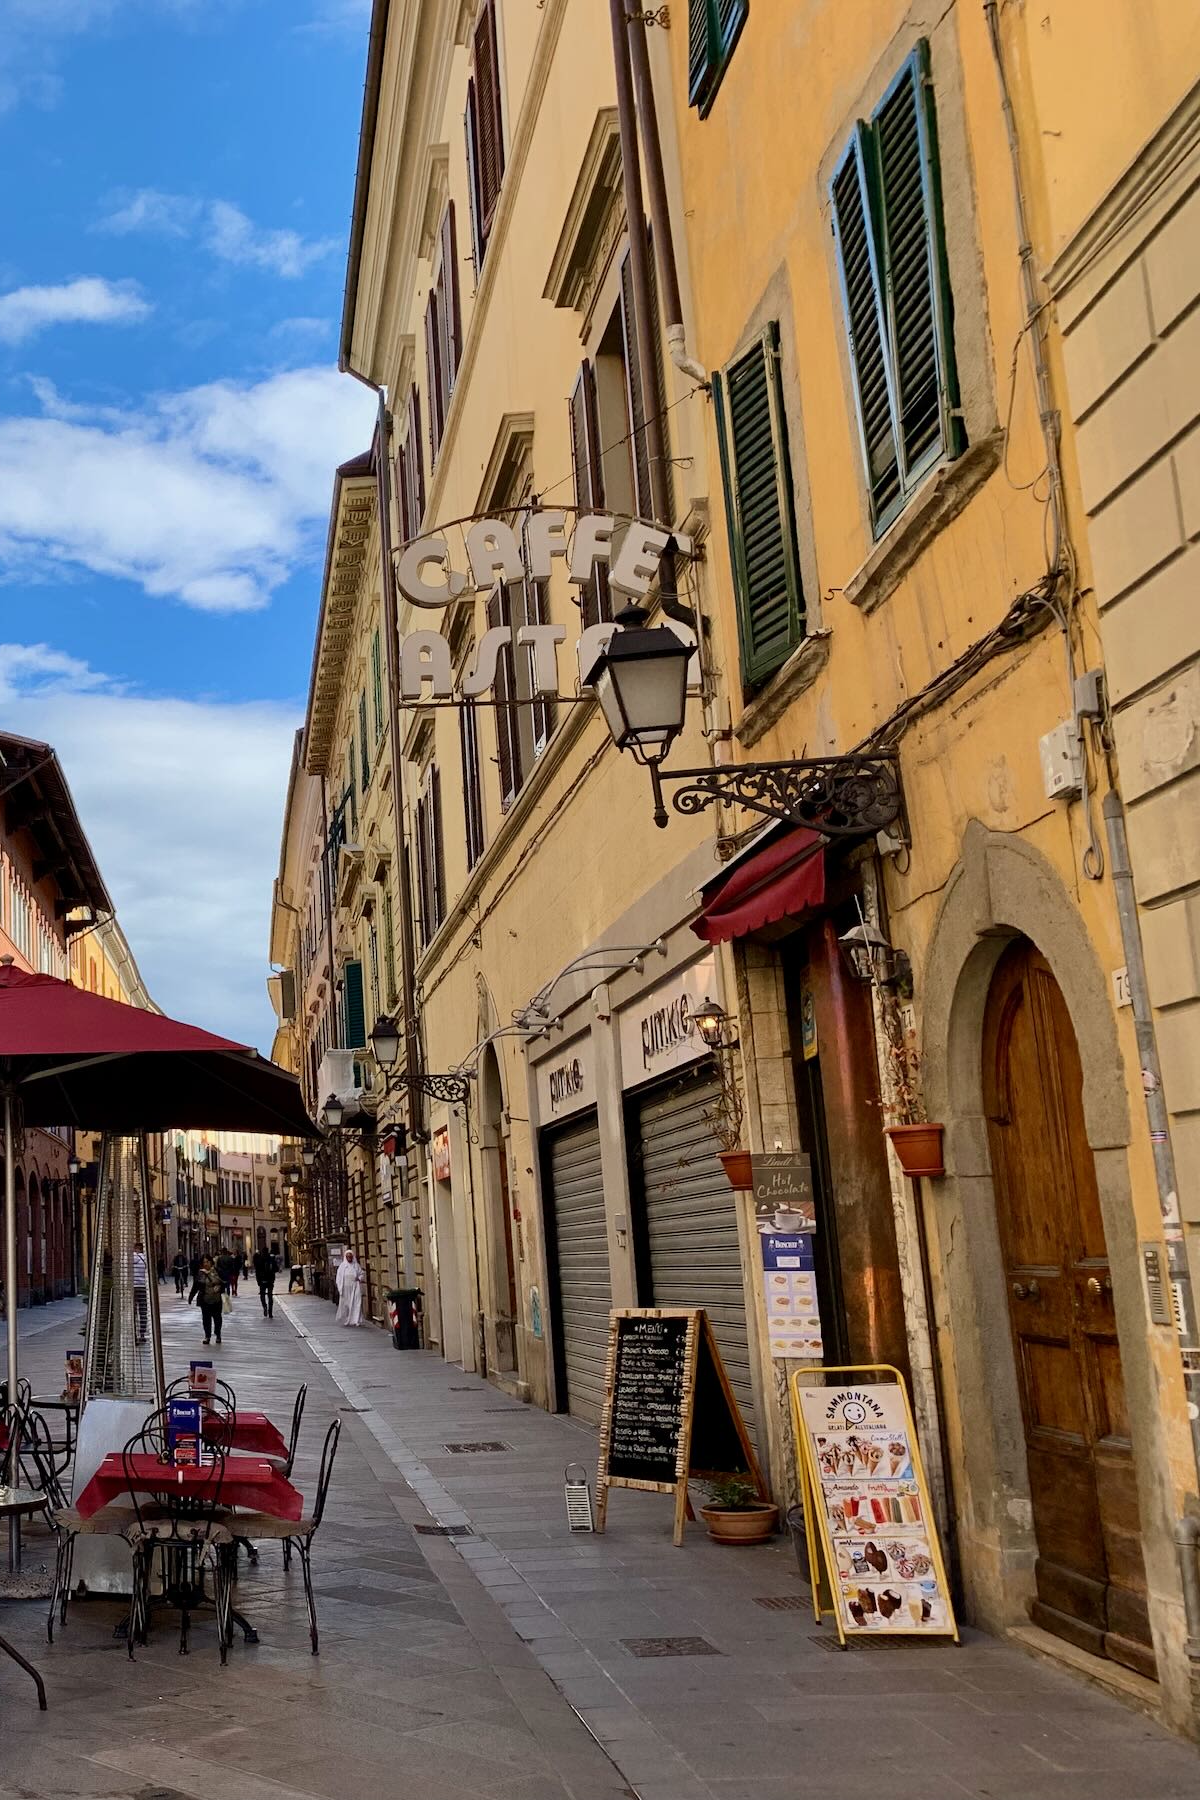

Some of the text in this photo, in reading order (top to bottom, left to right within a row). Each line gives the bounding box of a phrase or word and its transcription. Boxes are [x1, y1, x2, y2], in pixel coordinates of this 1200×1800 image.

[397, 512, 693, 608] CAFFE
[641, 992, 694, 1072] pimkie
[757, 1181, 809, 1198] Chocolate
[772, 1172, 792, 1187] Hot
[826, 1391, 884, 1419] SAMMONTANA
